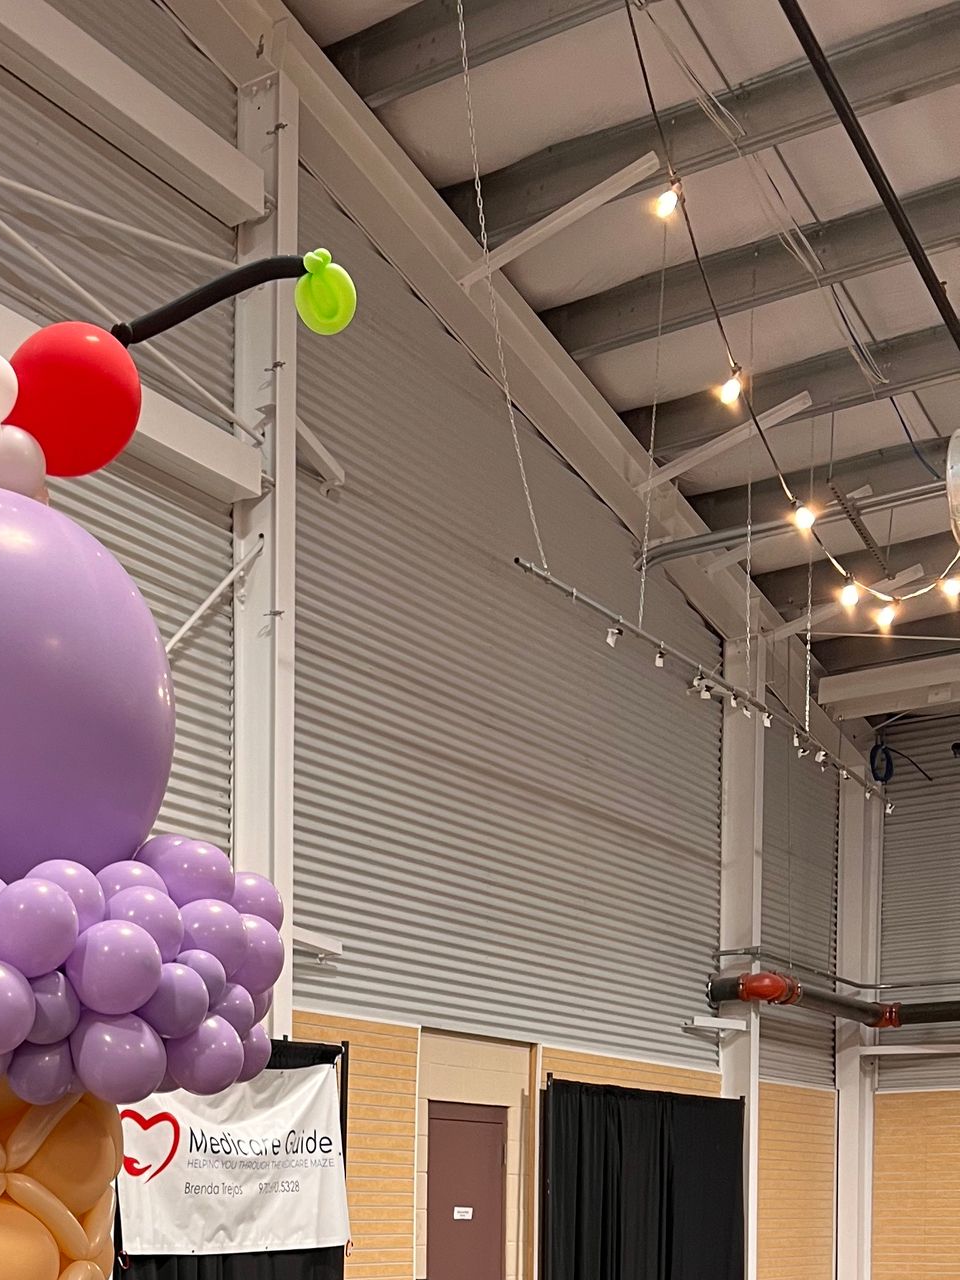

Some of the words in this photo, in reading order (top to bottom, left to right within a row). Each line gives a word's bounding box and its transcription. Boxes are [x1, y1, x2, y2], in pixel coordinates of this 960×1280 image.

[189, 1126, 281, 1156] Medicare
[285, 1129, 333, 1155] Guide
[187, 1158, 220, 1169] HELPING
[221, 1159, 237, 1170] YOU
[310, 1158, 335, 1169] MAZE
[184, 1182, 220, 1195] Brenda
[221, 1182, 243, 1198] Trejos
